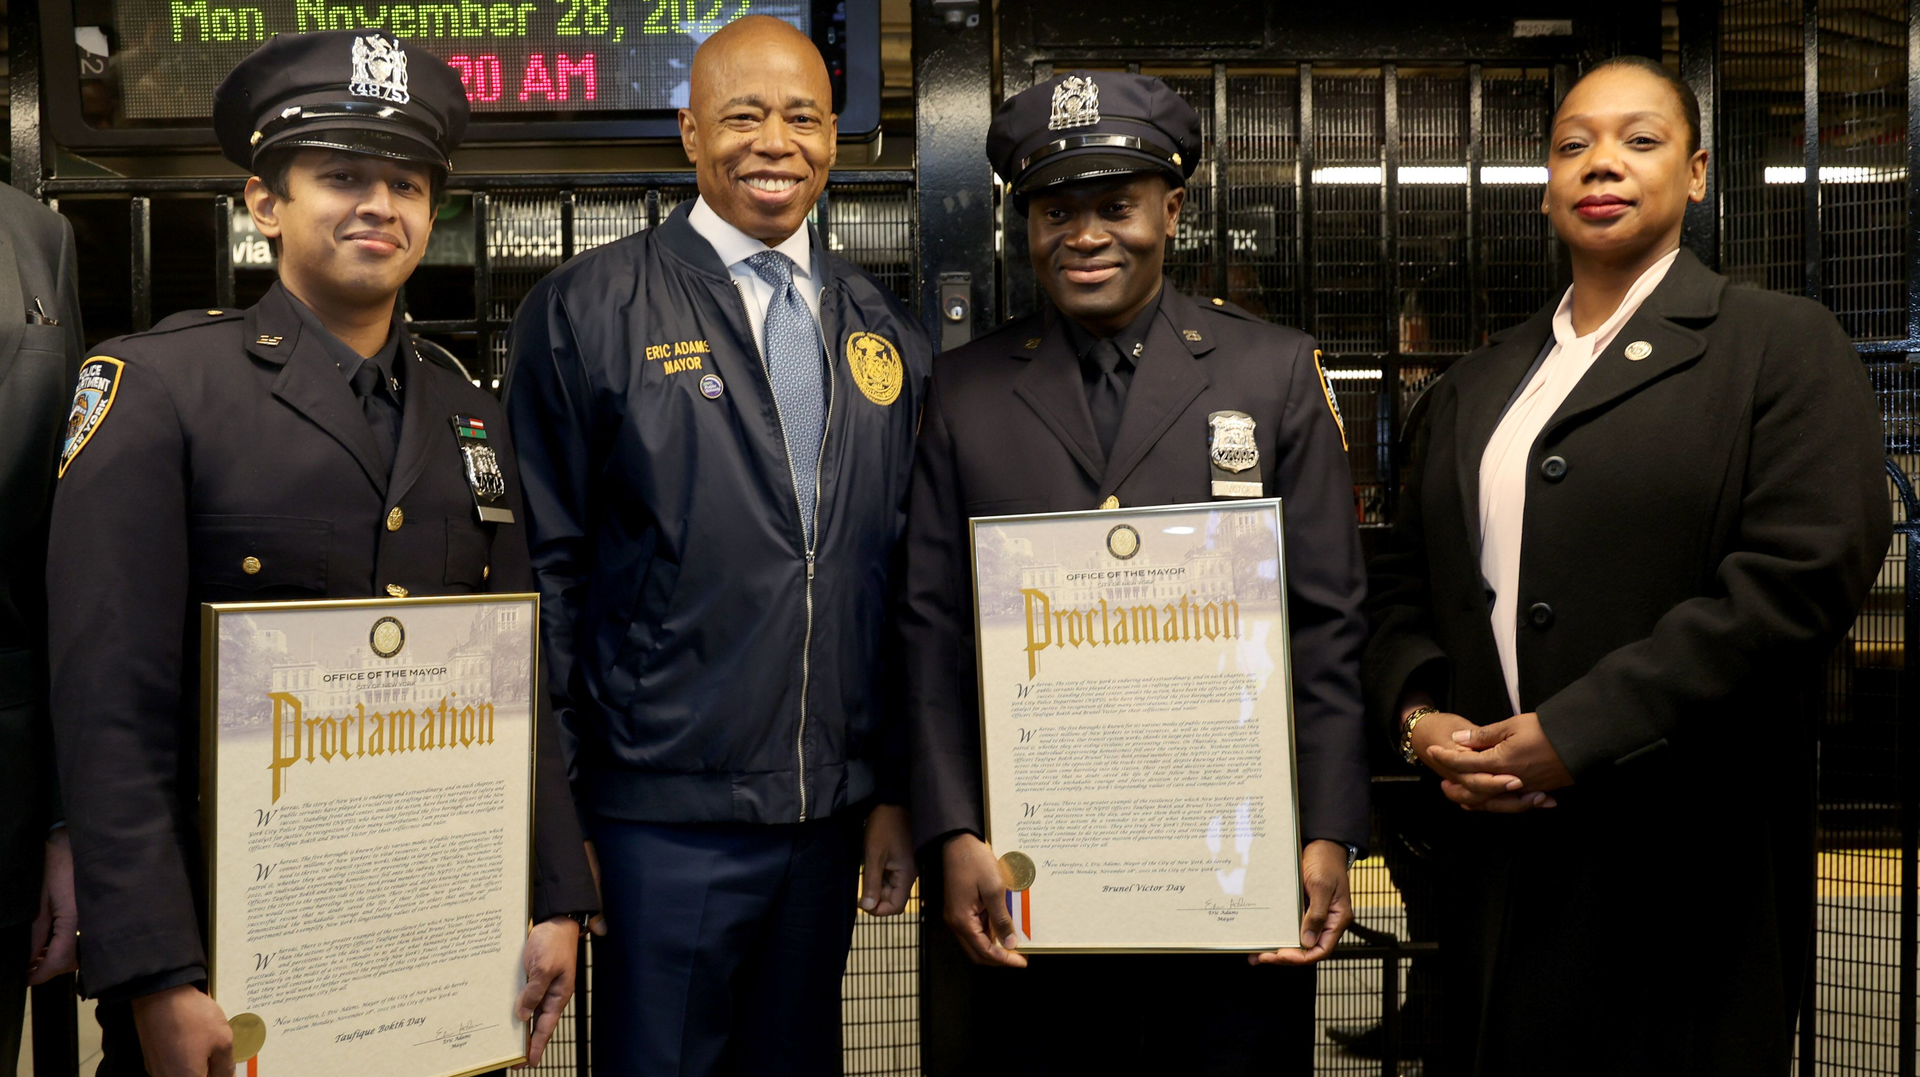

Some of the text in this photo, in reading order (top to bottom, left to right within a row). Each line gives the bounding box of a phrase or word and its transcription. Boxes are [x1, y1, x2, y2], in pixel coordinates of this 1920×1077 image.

[171, 0, 279, 41] Mon
[296, 0, 538, 38] November
[556, 0, 625, 43] 28,
[519, 53, 596, 101] AM
[232, 234, 273, 264] via
[645, 340, 711, 361] ERIC ADAMS
[663, 355, 703, 376] MAYOR
[76, 376, 112, 394] ARTMENT
[83, 398, 109, 433] YORK
[1066, 567, 1186, 581] OFFICE OF THE MAYOR
[1018, 588, 1240, 682] Proclamation
[323, 667, 447, 682] OFFICE OF THE MAYOR
[266, 692, 495, 805] Proclamation
[1102, 883, 1186, 893] Brunel Victor Day
[335, 1015, 427, 1044] Taufique Bokth Day
[454, 1033, 472, 1042] Adams
[451, 1041, 468, 1050] Mayor
